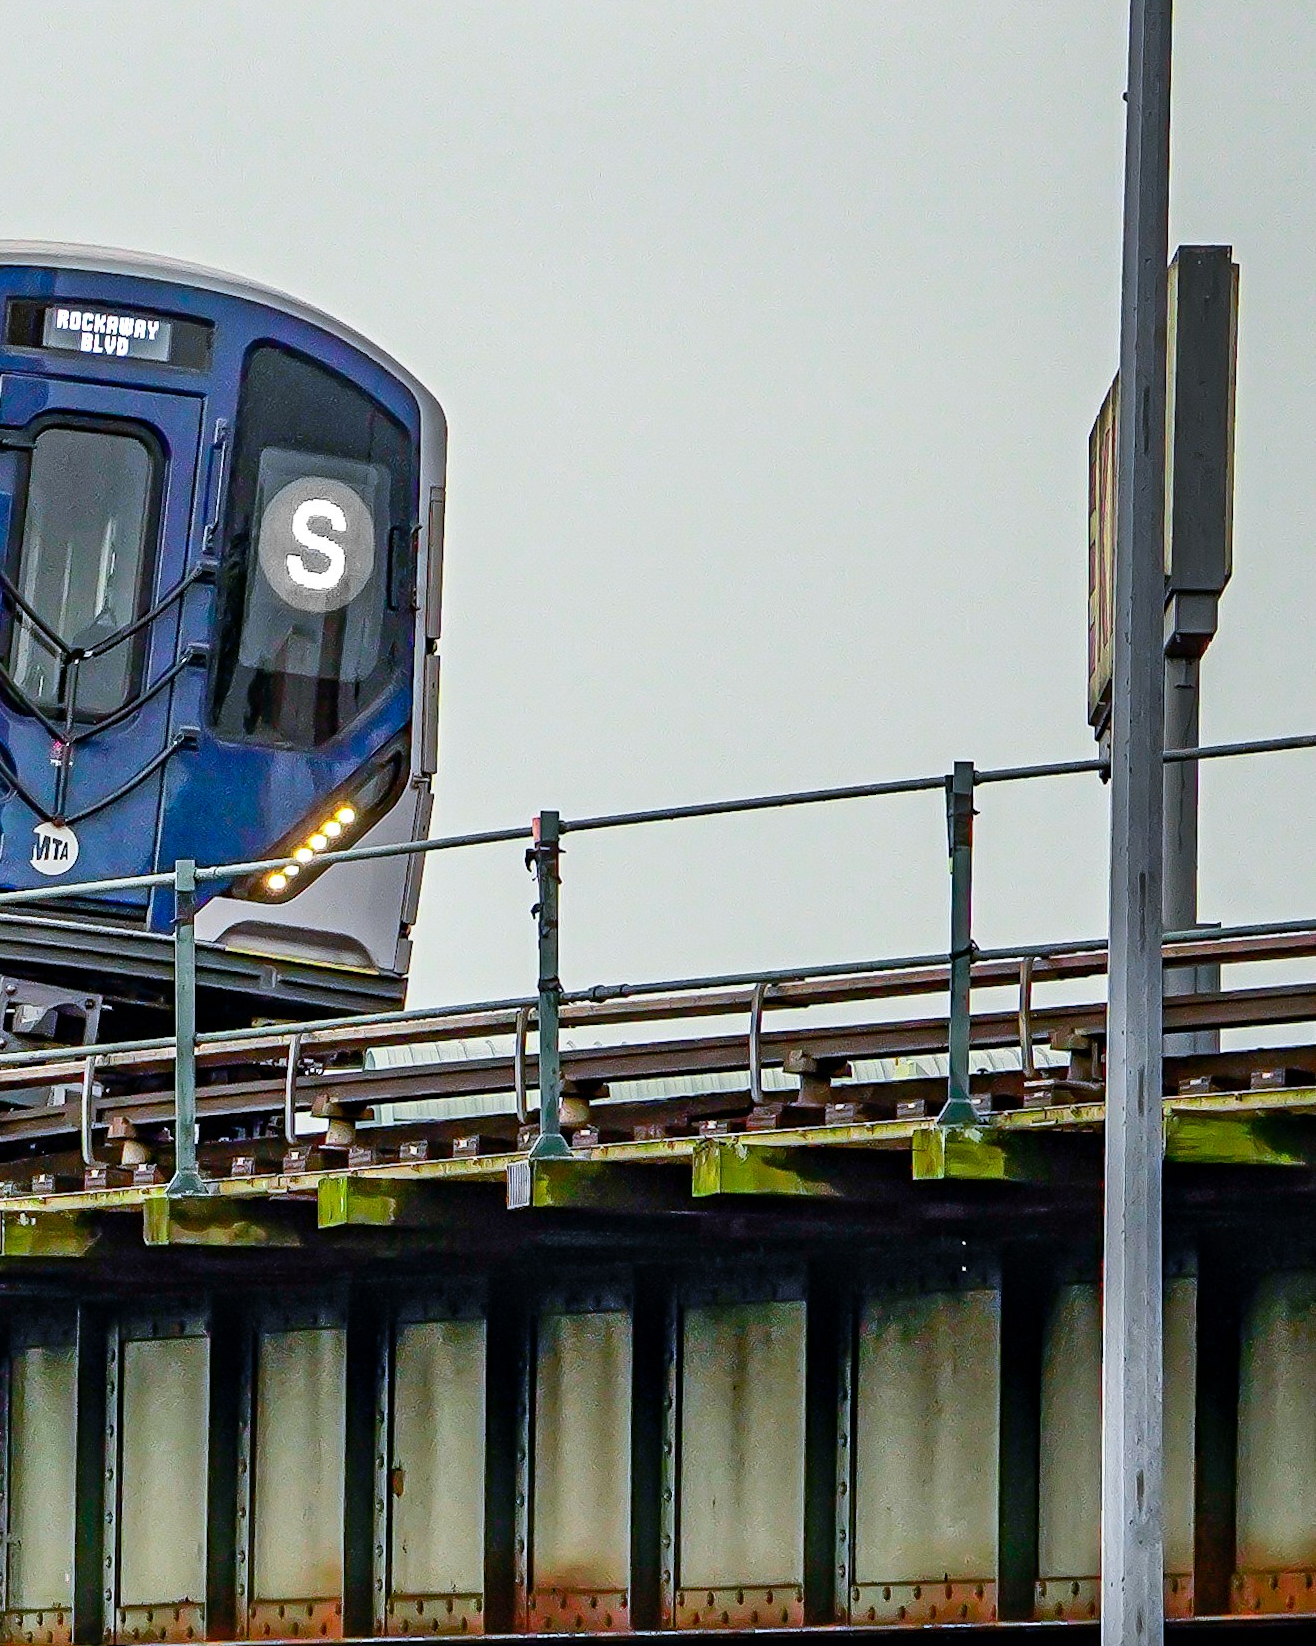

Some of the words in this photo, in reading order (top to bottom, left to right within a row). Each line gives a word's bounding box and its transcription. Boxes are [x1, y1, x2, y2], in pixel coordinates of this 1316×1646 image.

[56, 309, 160, 340] ROCKAWAY
[80, 332, 129, 357] BLVD
[286, 498, 347, 591] S
[30, 834, 69, 861] MTA
